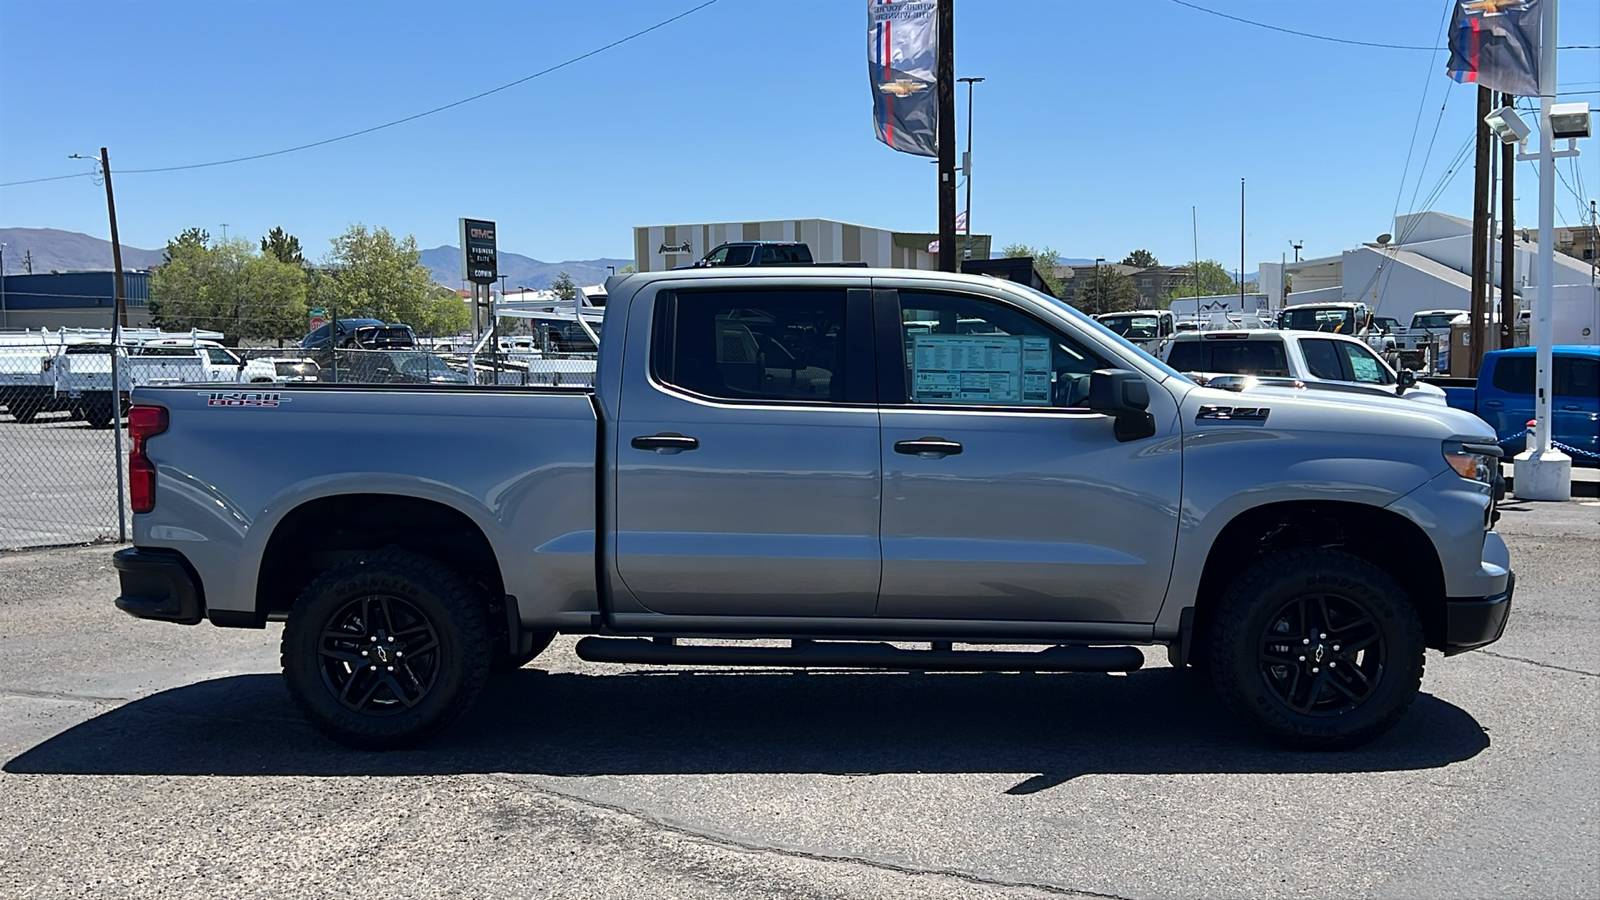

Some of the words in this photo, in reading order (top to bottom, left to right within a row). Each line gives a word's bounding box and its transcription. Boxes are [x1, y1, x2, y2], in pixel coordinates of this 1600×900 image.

[470, 228, 494, 240] GMC
[471, 247, 494, 255] BUSINESS
[476, 255, 490, 263] ELITE
[474, 269, 493, 278] CORWIN
[198, 392, 292, 402] TRAIL
